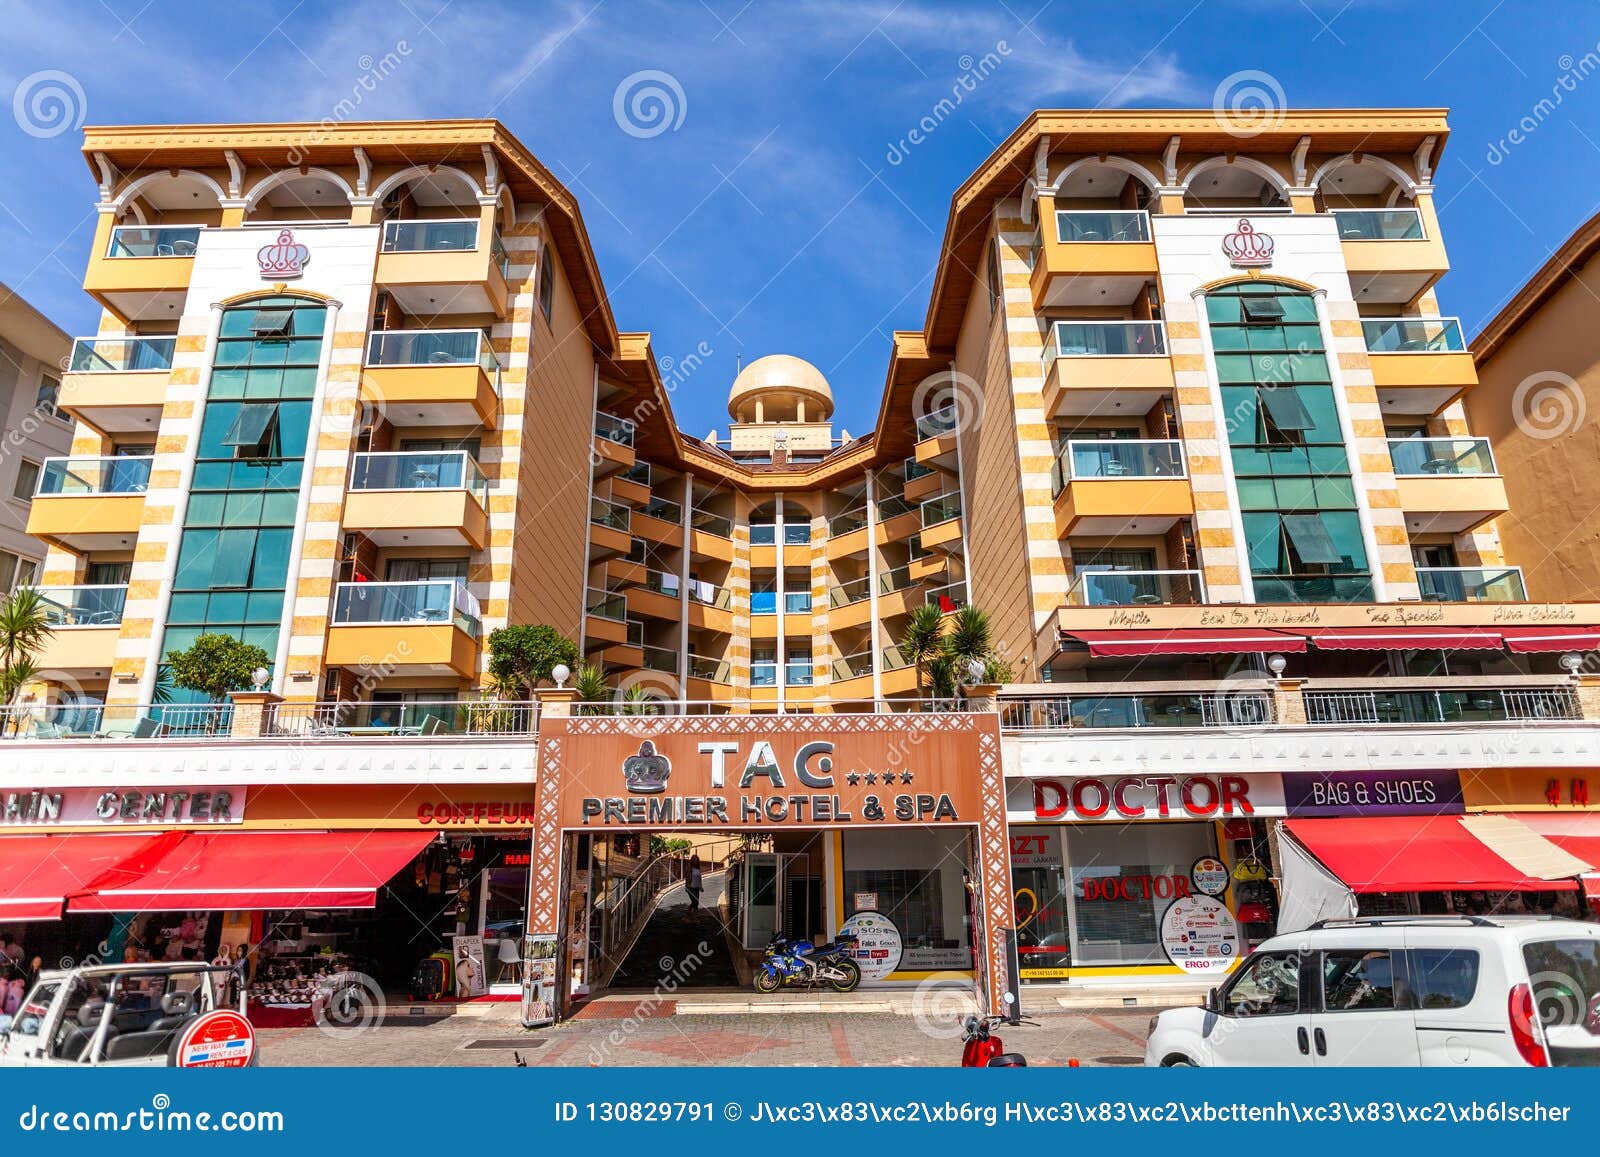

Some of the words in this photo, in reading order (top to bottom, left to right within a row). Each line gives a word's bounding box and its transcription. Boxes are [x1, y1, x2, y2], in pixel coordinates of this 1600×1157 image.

[0, 788, 63, 822] HİN
[96, 792, 233, 820] CENTER
[1032, 775, 1255, 820] DOCTOR
[1312, 782, 1350, 805] BAG
[1354, 782, 1371, 804] &
[1375, 780, 1436, 804] SHOES
[417, 802, 535, 825] COIFFEUR
[581, 796, 729, 824] PREMIER
[740, 795, 852, 822] HOTEL
[862, 795, 886, 821] &
[894, 793, 959, 821] SPA
[1083, 874, 1194, 900] DOCTOR
[1184, 960, 1210, 969] ERGO
